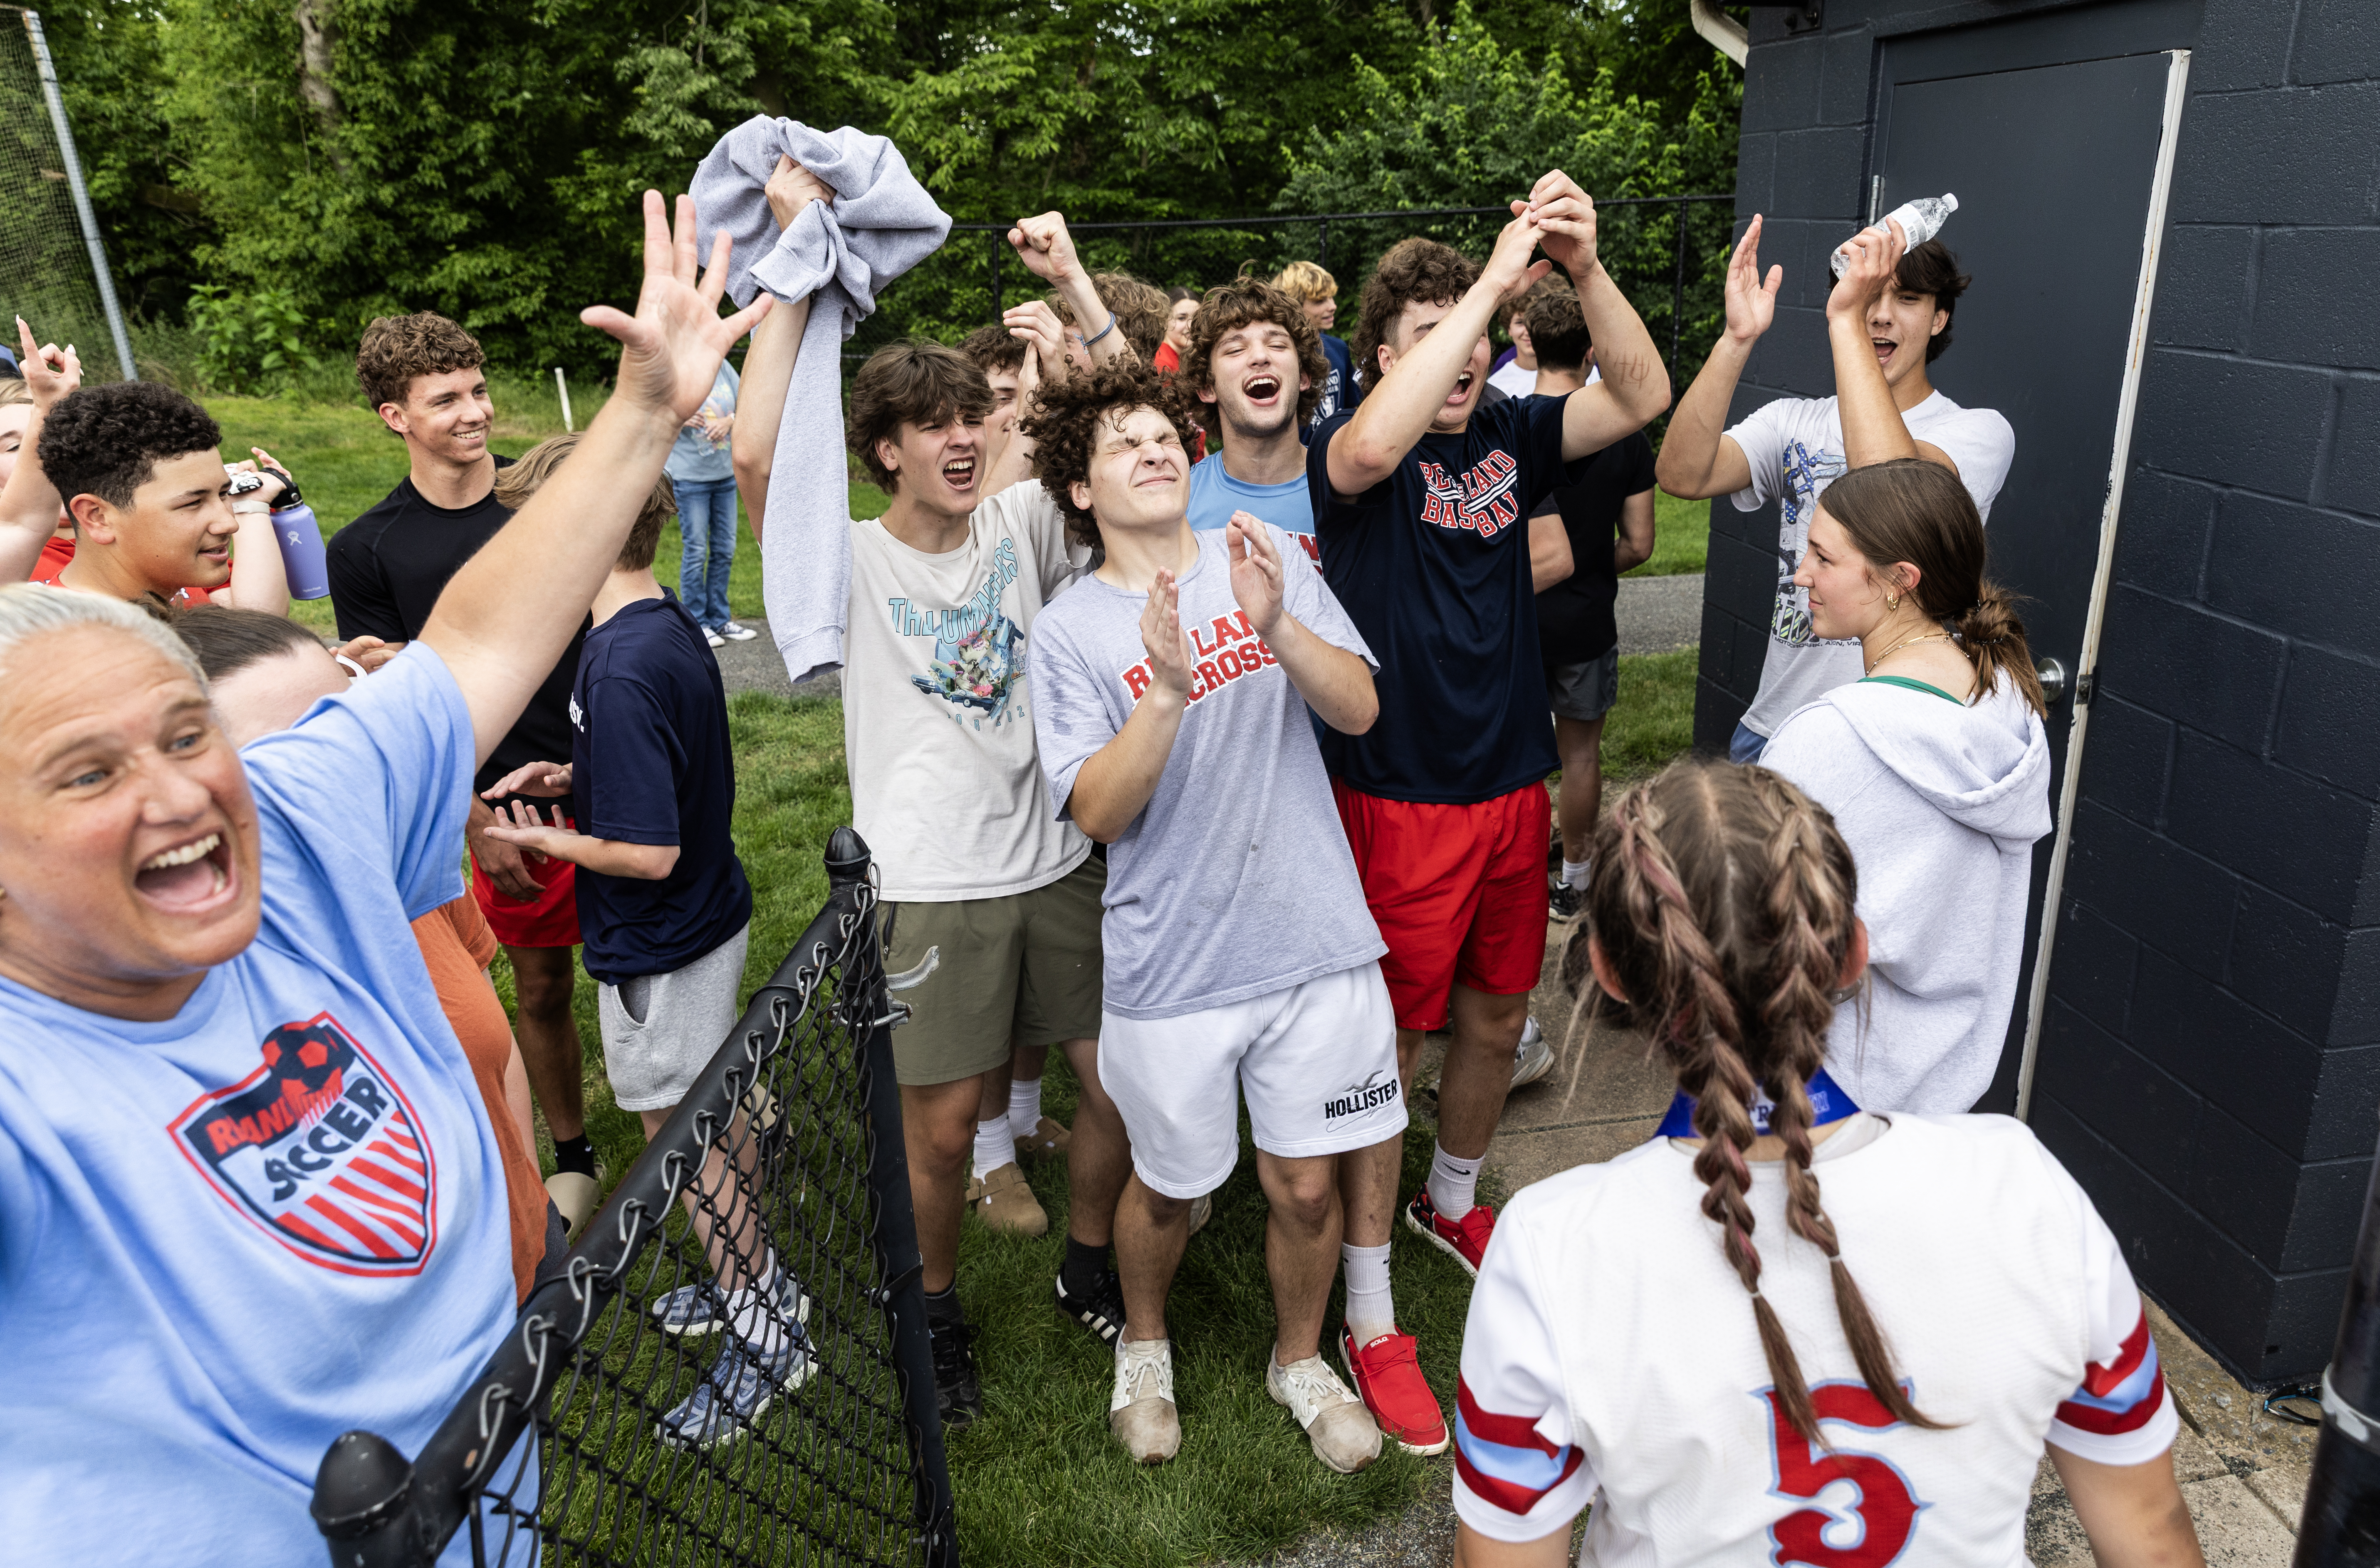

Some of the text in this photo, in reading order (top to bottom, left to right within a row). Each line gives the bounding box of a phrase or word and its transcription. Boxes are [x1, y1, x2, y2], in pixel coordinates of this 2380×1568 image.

[1325, 1078, 1397, 1119] HOLLISTER
[1370, 1336, 1388, 1348] SOLO
[1746, 1376, 1936, 1568] 5
